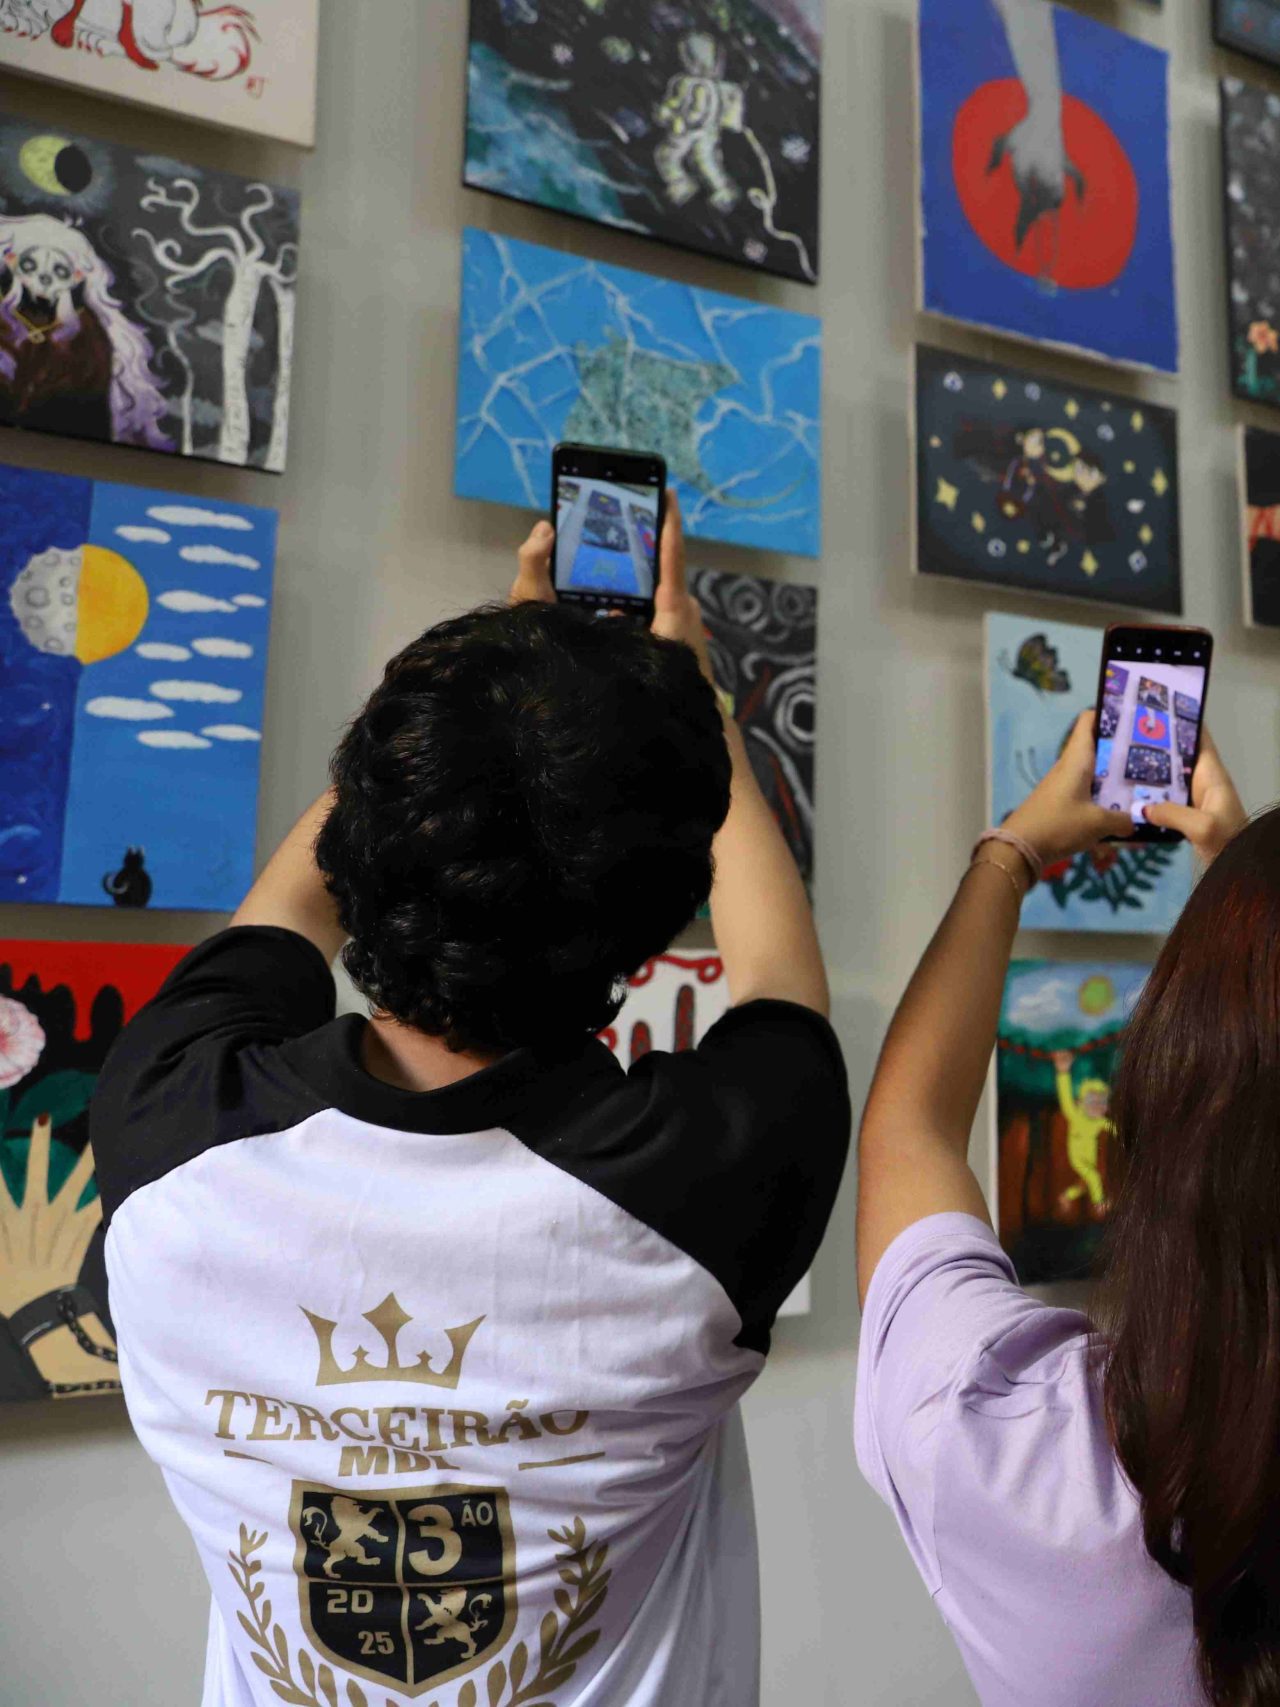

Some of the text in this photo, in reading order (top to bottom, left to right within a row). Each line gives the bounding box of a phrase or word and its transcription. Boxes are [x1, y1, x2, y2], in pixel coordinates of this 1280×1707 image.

[204, 1388, 591, 1452] TERCEIRÃO
[326, 1588, 374, 1615] 20
[357, 1630, 395, 1656] 25
